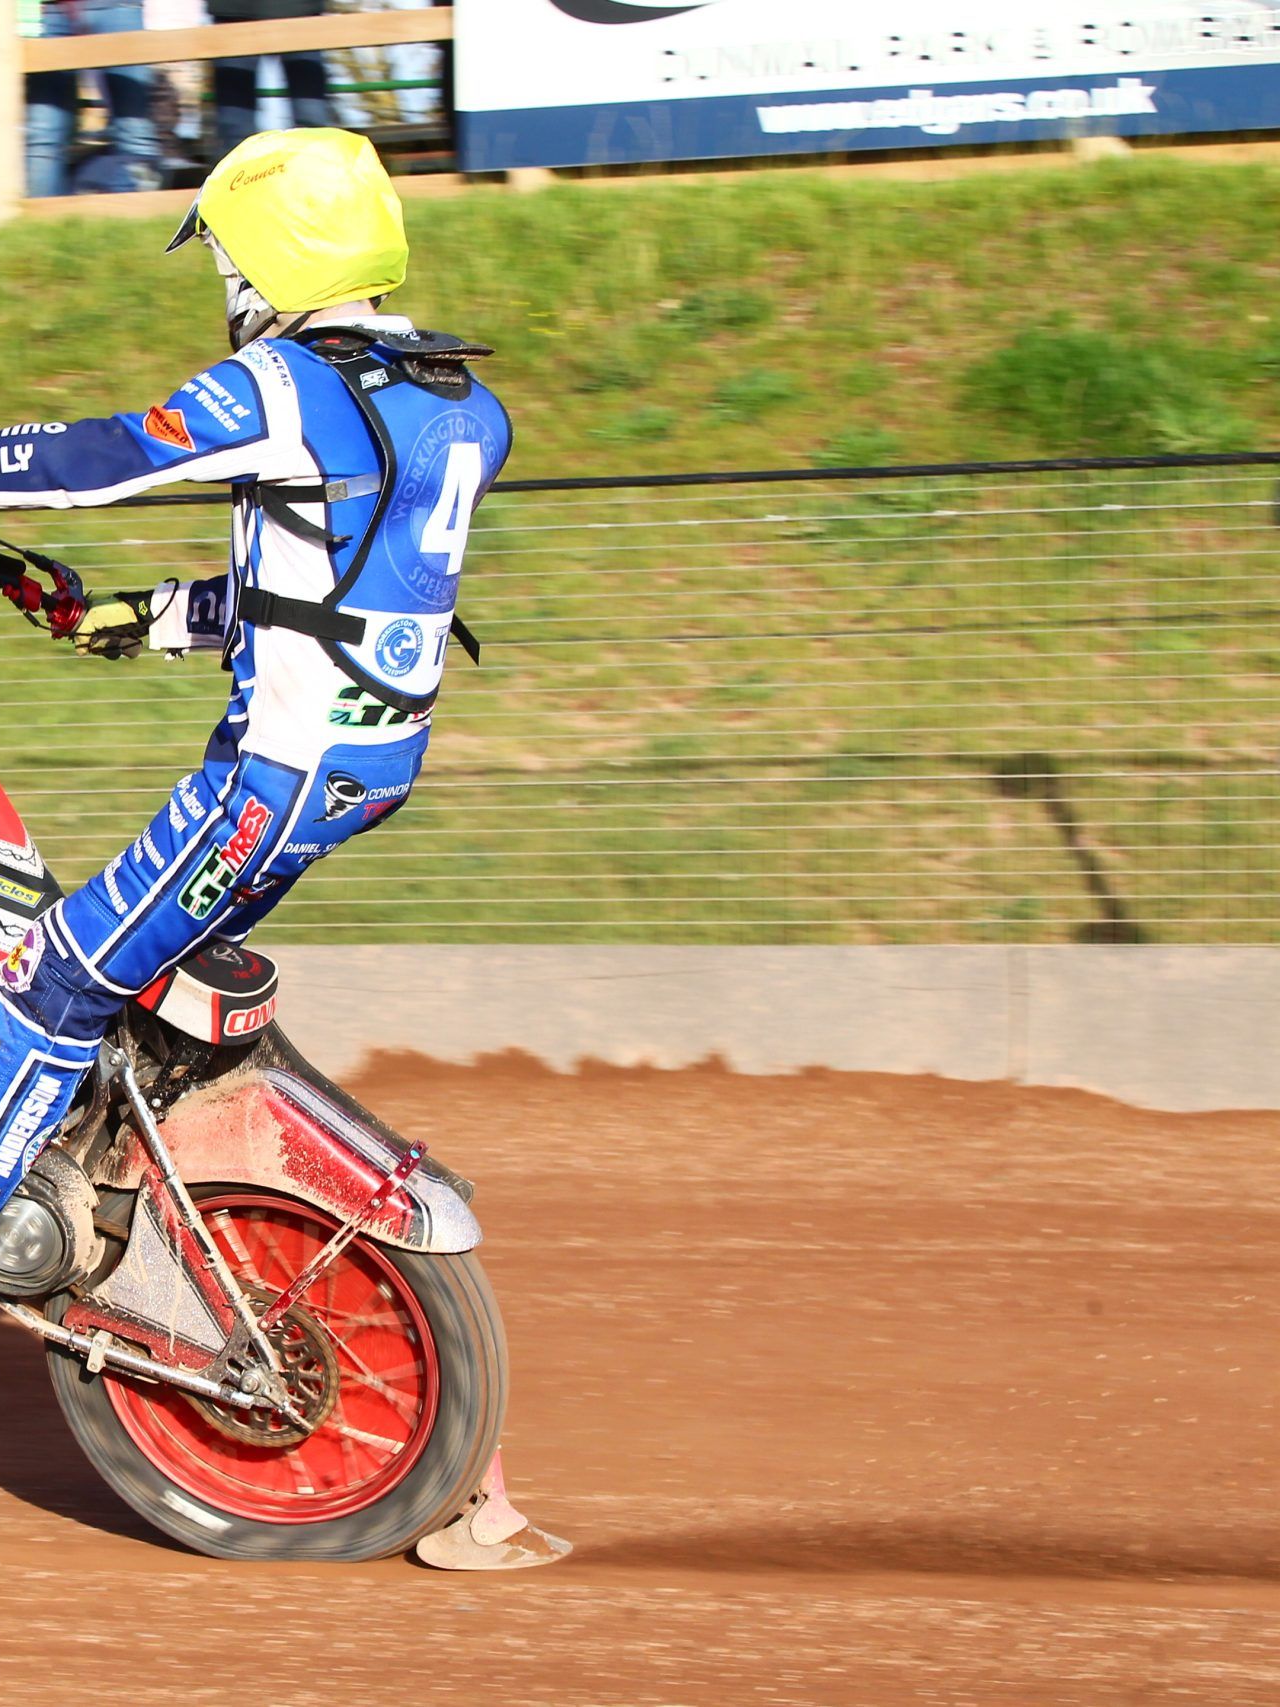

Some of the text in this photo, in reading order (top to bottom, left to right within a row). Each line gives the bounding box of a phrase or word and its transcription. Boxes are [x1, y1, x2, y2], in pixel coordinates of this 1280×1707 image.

[230, 164, 285, 191] Connor
[419, 443, 482, 576] 4
[367, 783, 410, 801] CONNOR
